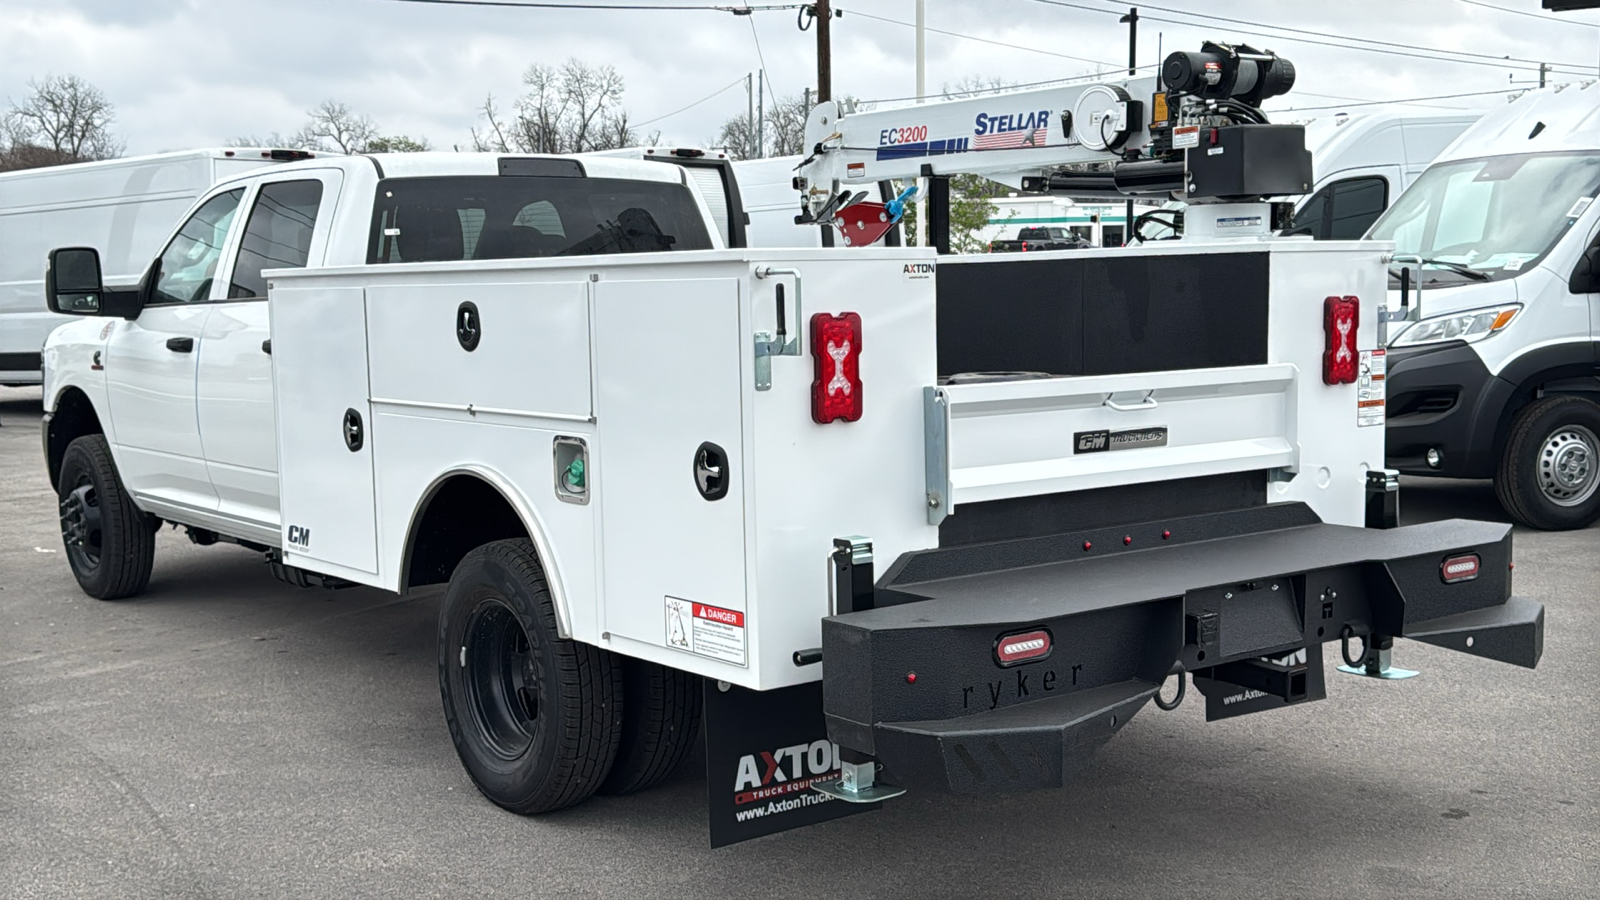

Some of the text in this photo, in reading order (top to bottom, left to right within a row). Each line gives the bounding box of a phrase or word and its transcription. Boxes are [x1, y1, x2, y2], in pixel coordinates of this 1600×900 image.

[974, 110, 1049, 136] STELLAR
[879, 125, 928, 146] EC3200
[903, 263, 935, 274] AXTON
[1078, 433, 1107, 450] CM
[287, 525, 311, 547] CM
[707, 608, 737, 623] DANGER
[962, 664, 1083, 710] ryker
[753, 786, 784, 799] TRUCK
